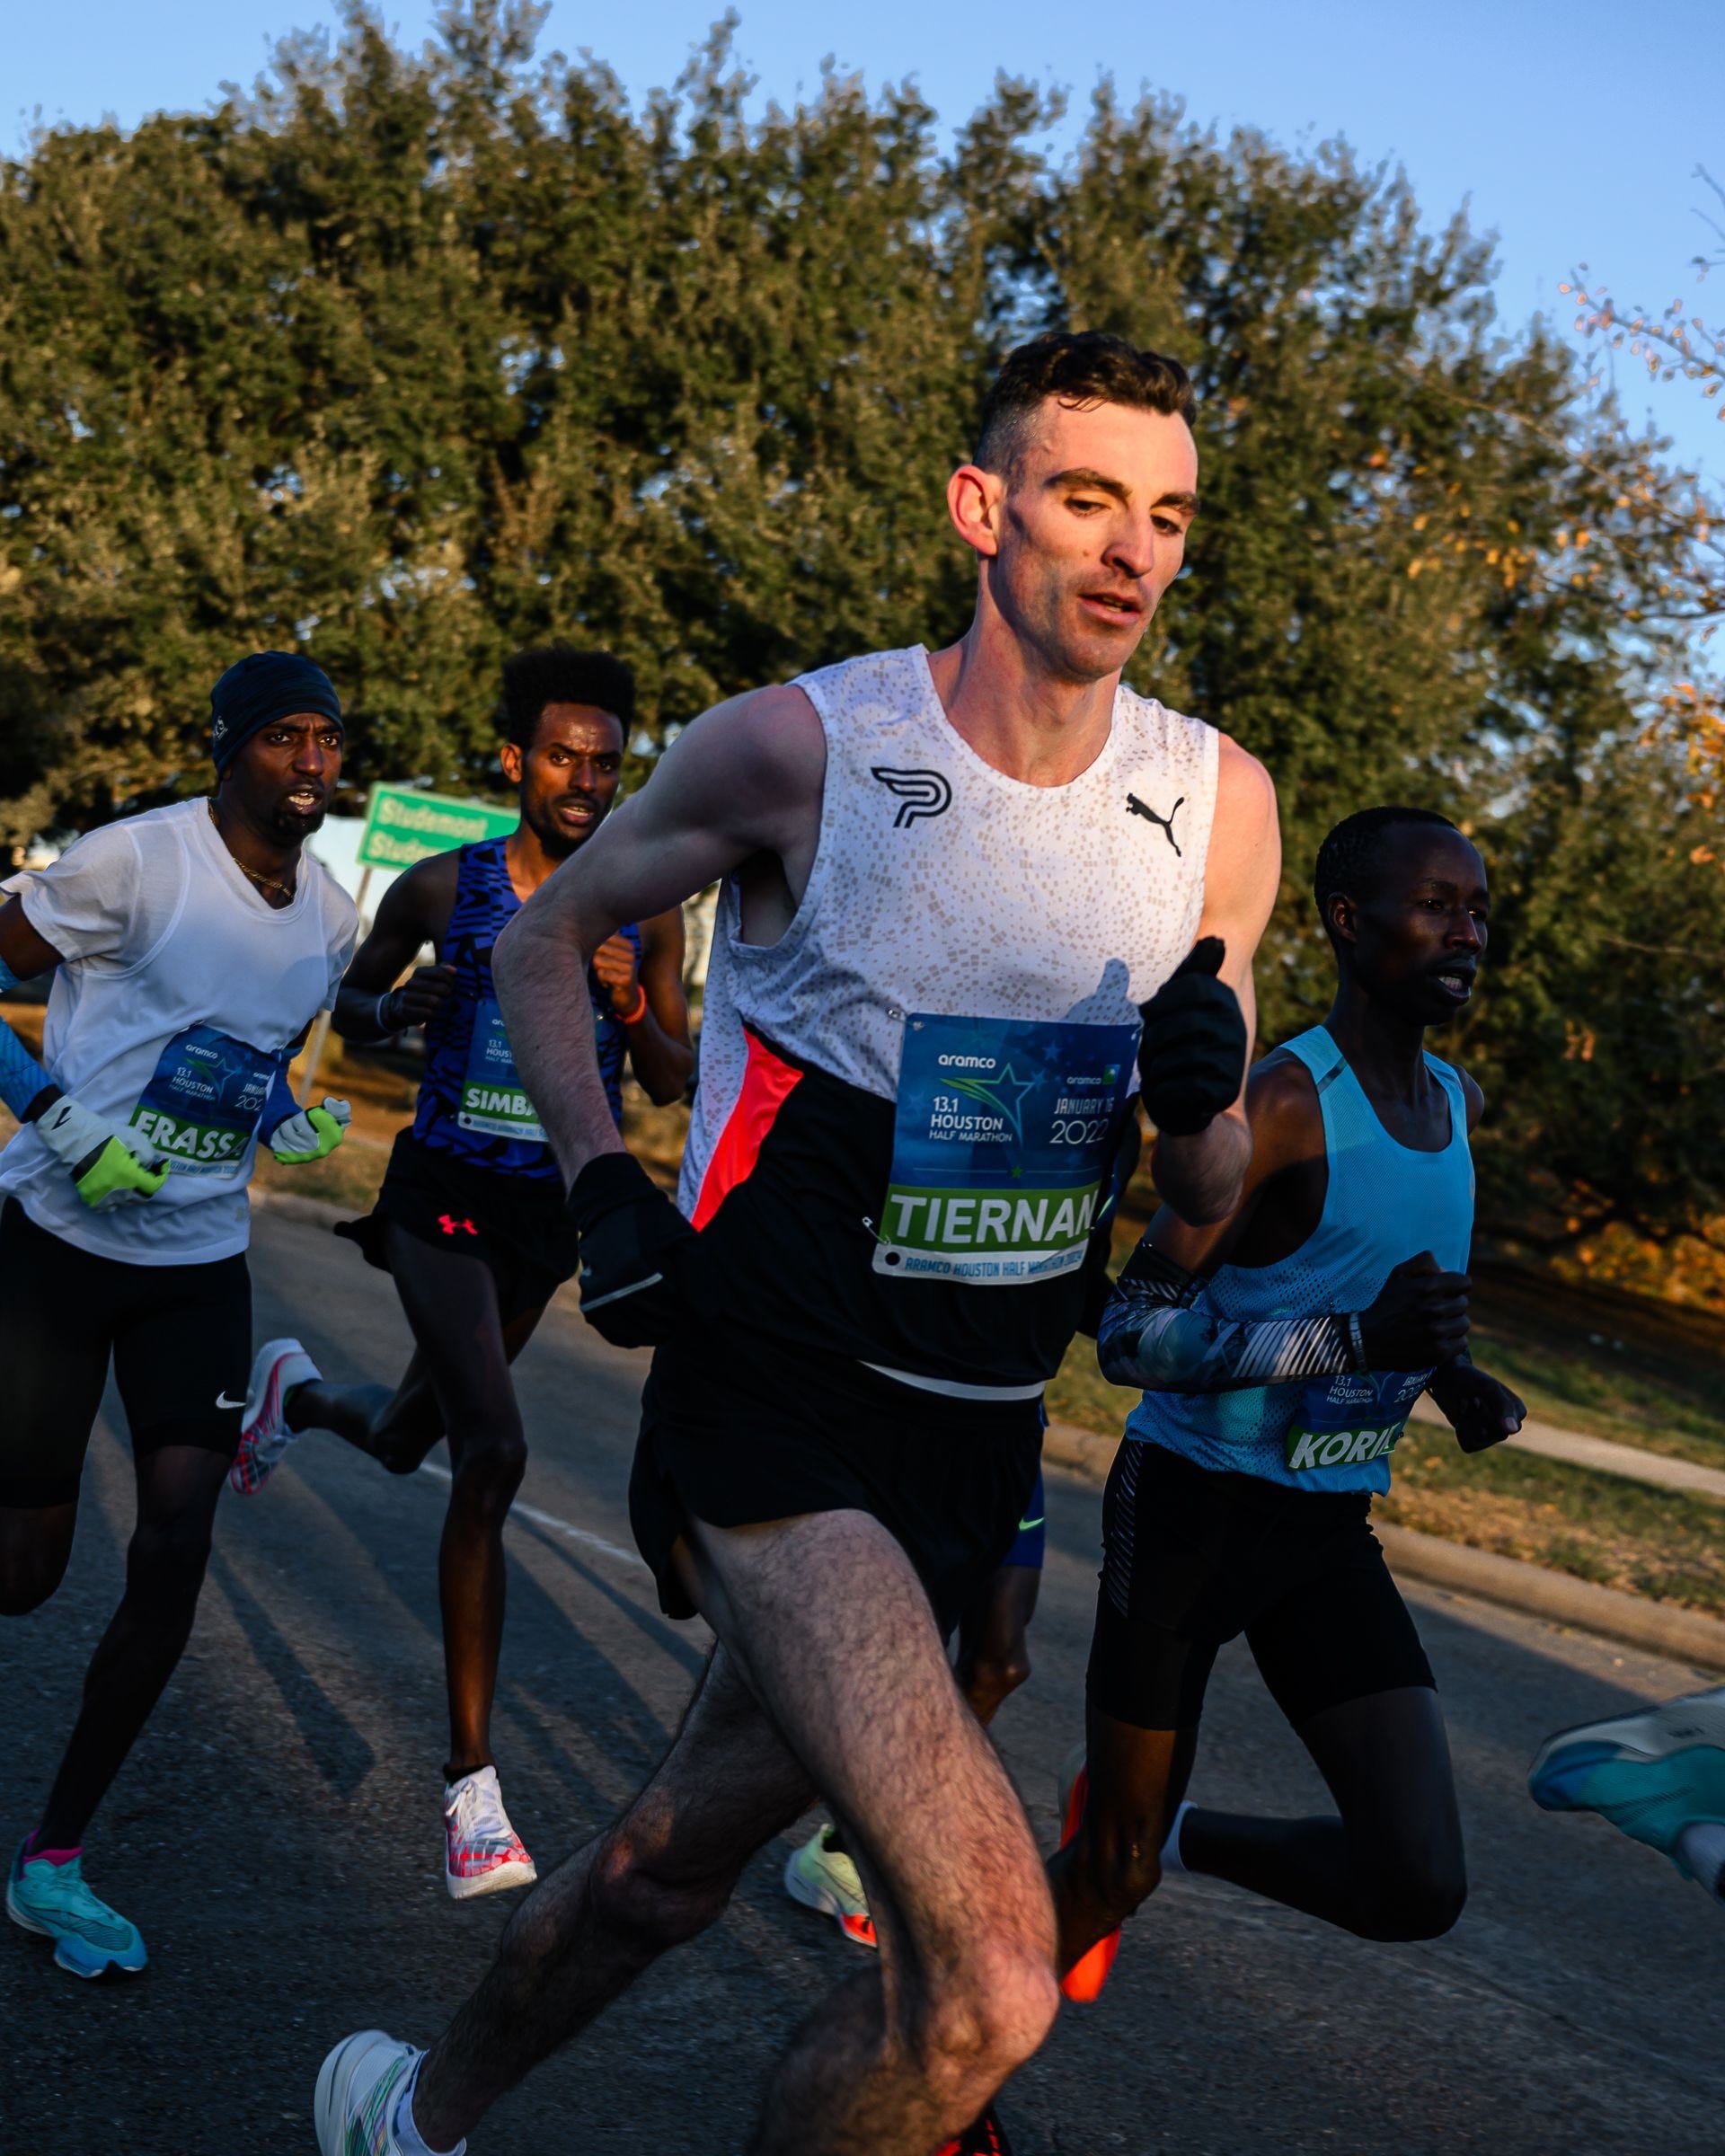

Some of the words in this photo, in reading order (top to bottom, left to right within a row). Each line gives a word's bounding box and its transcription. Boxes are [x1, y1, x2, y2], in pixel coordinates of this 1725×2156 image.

[378, 796, 488, 841] Studemont
[488, 1039, 502, 1048] 13.1
[185, 1044, 218, 1060] aramco
[938, 1054, 996, 1069] aramco
[177, 1066, 192, 1079] 13.1
[1066, 1076, 1102, 1085] aramco
[172, 1076, 214, 1094] HOUSTON
[933, 1096, 959, 1113] 13.1
[1054, 1097, 1104, 1115] JANUARY
[931, 1114, 1004, 1130] HOUSTON
[929, 1131, 956, 1141] HALF
[958, 1132, 1013, 1143] MARATHON
[1049, 1118, 1109, 1144] 2022
[890, 1188, 1100, 1244] TIERNAN
[905, 1257, 951, 1274] ARAMCO
[952, 1262, 1000, 1277] HOUSTON
[1002, 1262, 1026, 1276] HALF
[1335, 1374, 1352, 1387] 13.1
[1330, 1385, 1374, 1397] HOUSTON
[1326, 1395, 1346, 1405] HALF
